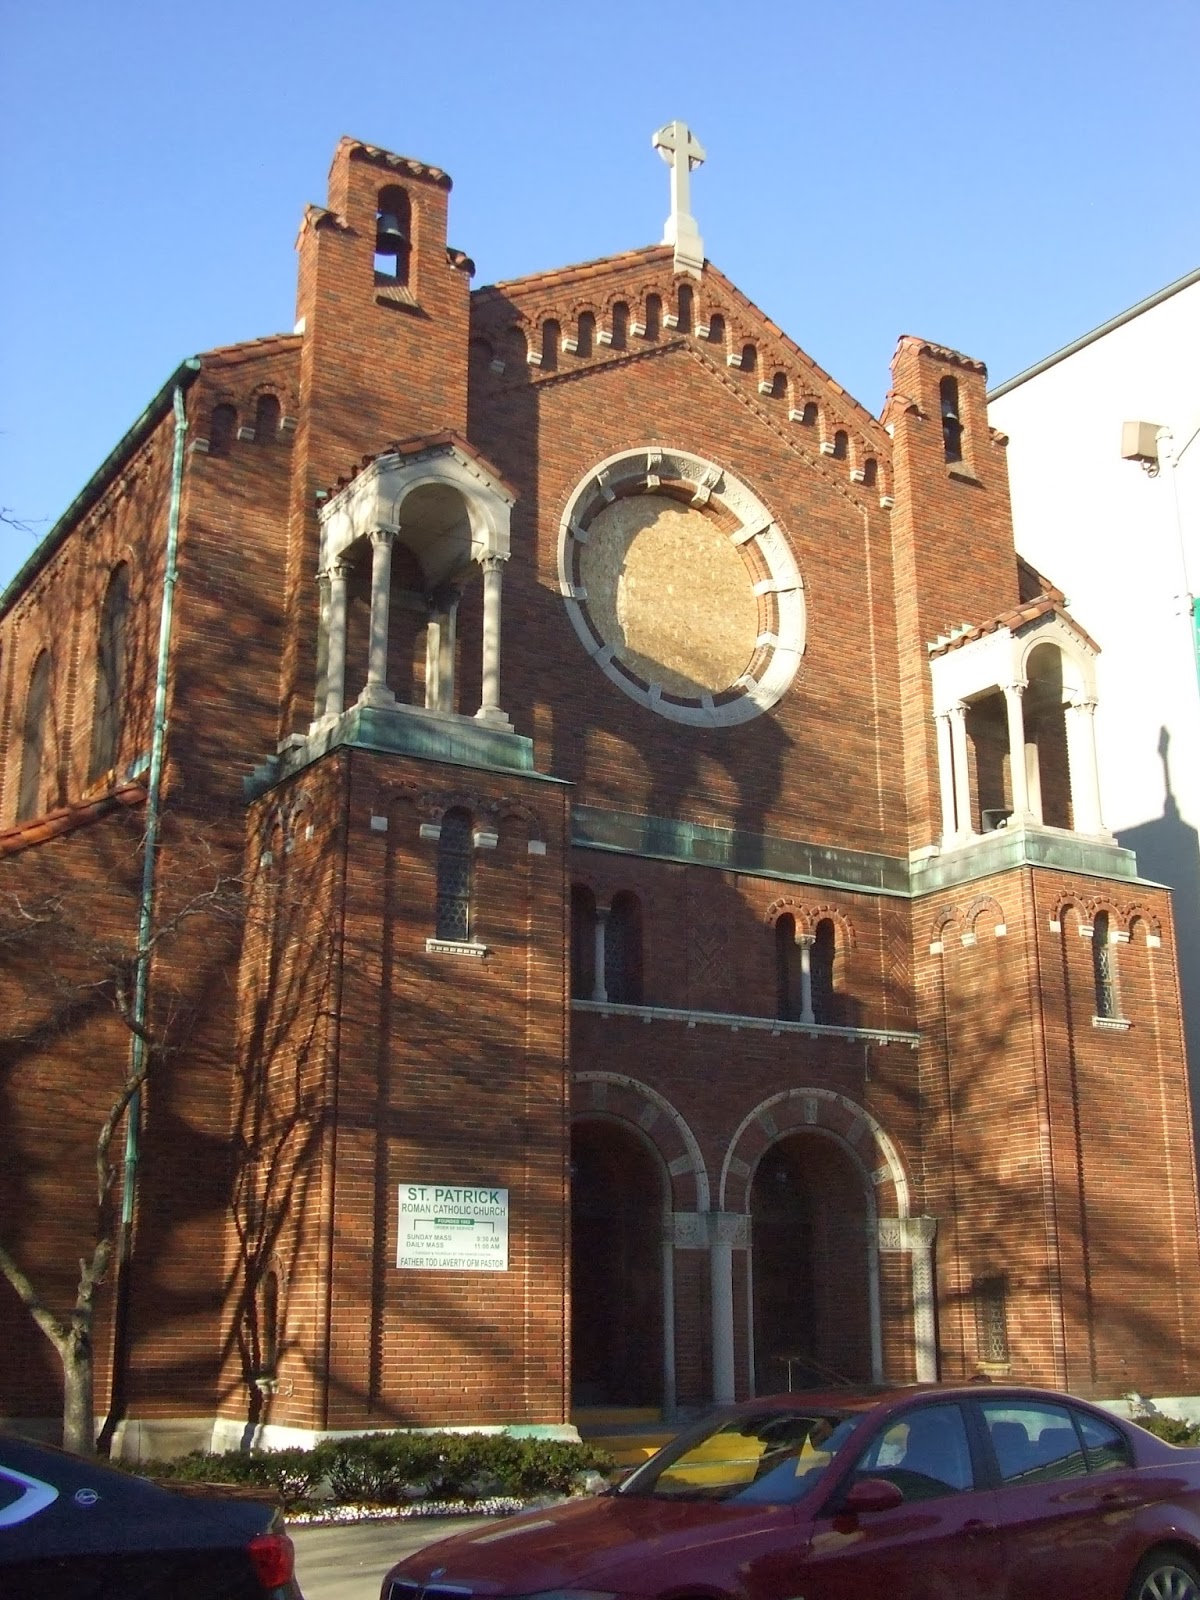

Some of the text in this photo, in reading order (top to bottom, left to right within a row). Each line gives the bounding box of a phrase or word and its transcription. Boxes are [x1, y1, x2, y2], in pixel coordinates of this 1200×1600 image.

[408, 1188, 499, 1204] ST. PATRICK
[402, 1203, 505, 1216] ROMAN CATHOLIC CHURCH
[400, 1257, 424, 1266] FATHER
[439, 1258, 465, 1267] LAVERTY
[466, 1259, 480, 1267] OFM
[480, 1259, 503, 1268] PASTOR
